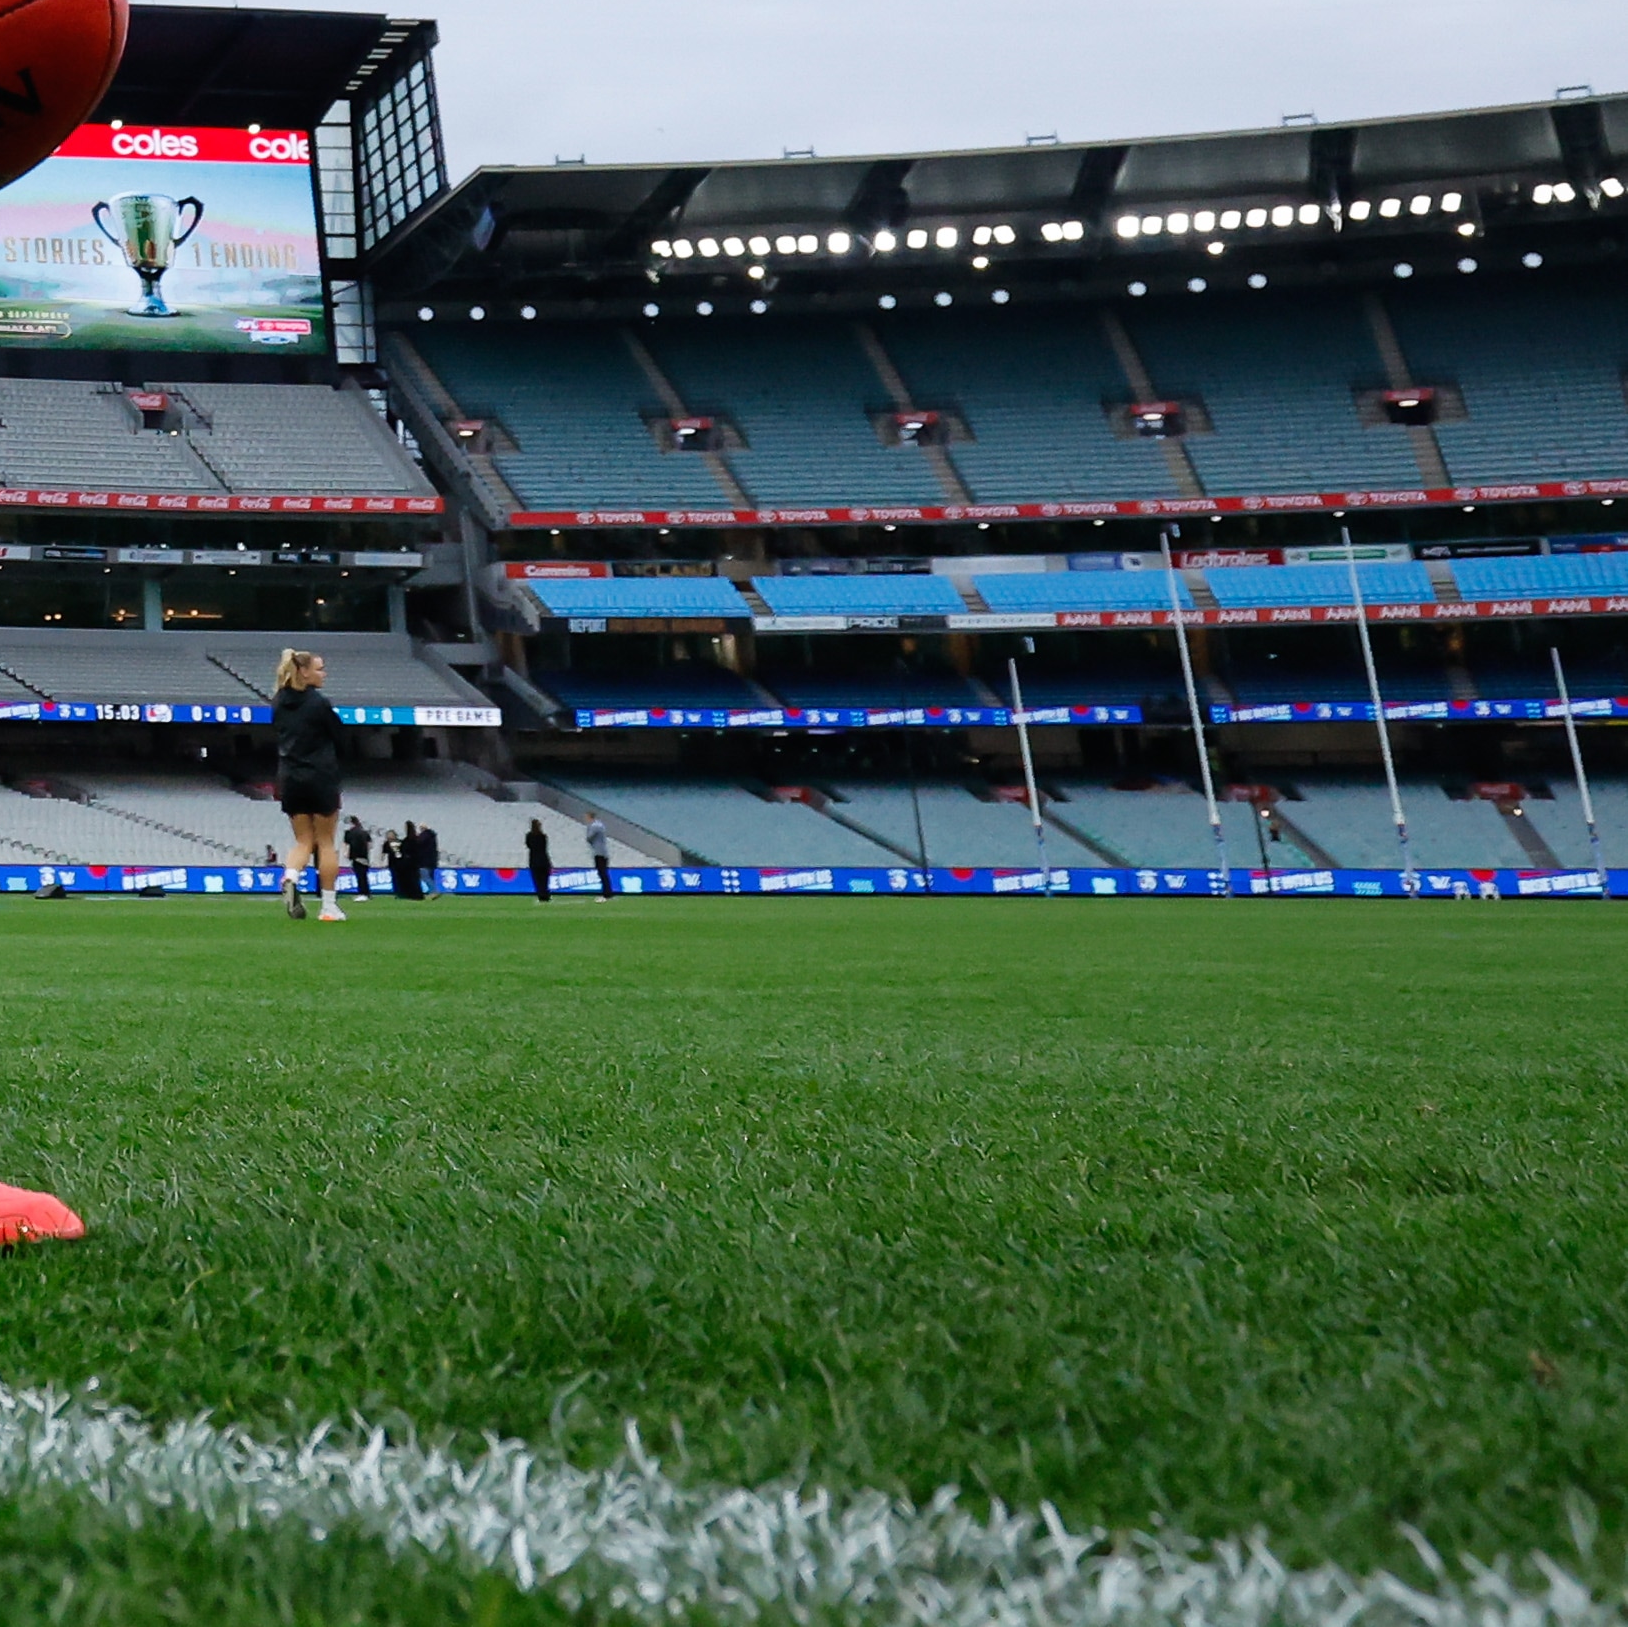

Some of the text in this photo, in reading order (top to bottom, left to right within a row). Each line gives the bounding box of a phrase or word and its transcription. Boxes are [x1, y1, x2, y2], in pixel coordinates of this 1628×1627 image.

[111, 129, 199, 158] coles
[210, 242, 298, 270] ENDING
[1370, 491, 1427, 503] TOYOTA
[1479, 486, 1539, 499] TOYOTA
[1162, 498, 1217, 510] TOYOTA
[1266, 495, 1323, 507] TOYOTA
[872, 509, 922, 519] TOYOTA
[966, 506, 1019, 517] TOYOTA
[1064, 503, 1117, 514] TOYOTA
[597, 513, 644, 523] TOYOTA
[687, 512, 736, 522] TOYOTA
[780, 511, 829, 521] TOYOTA
[1179, 550, 1270, 568] Ladbrokes
[96, 704, 140, 720] 15:03
